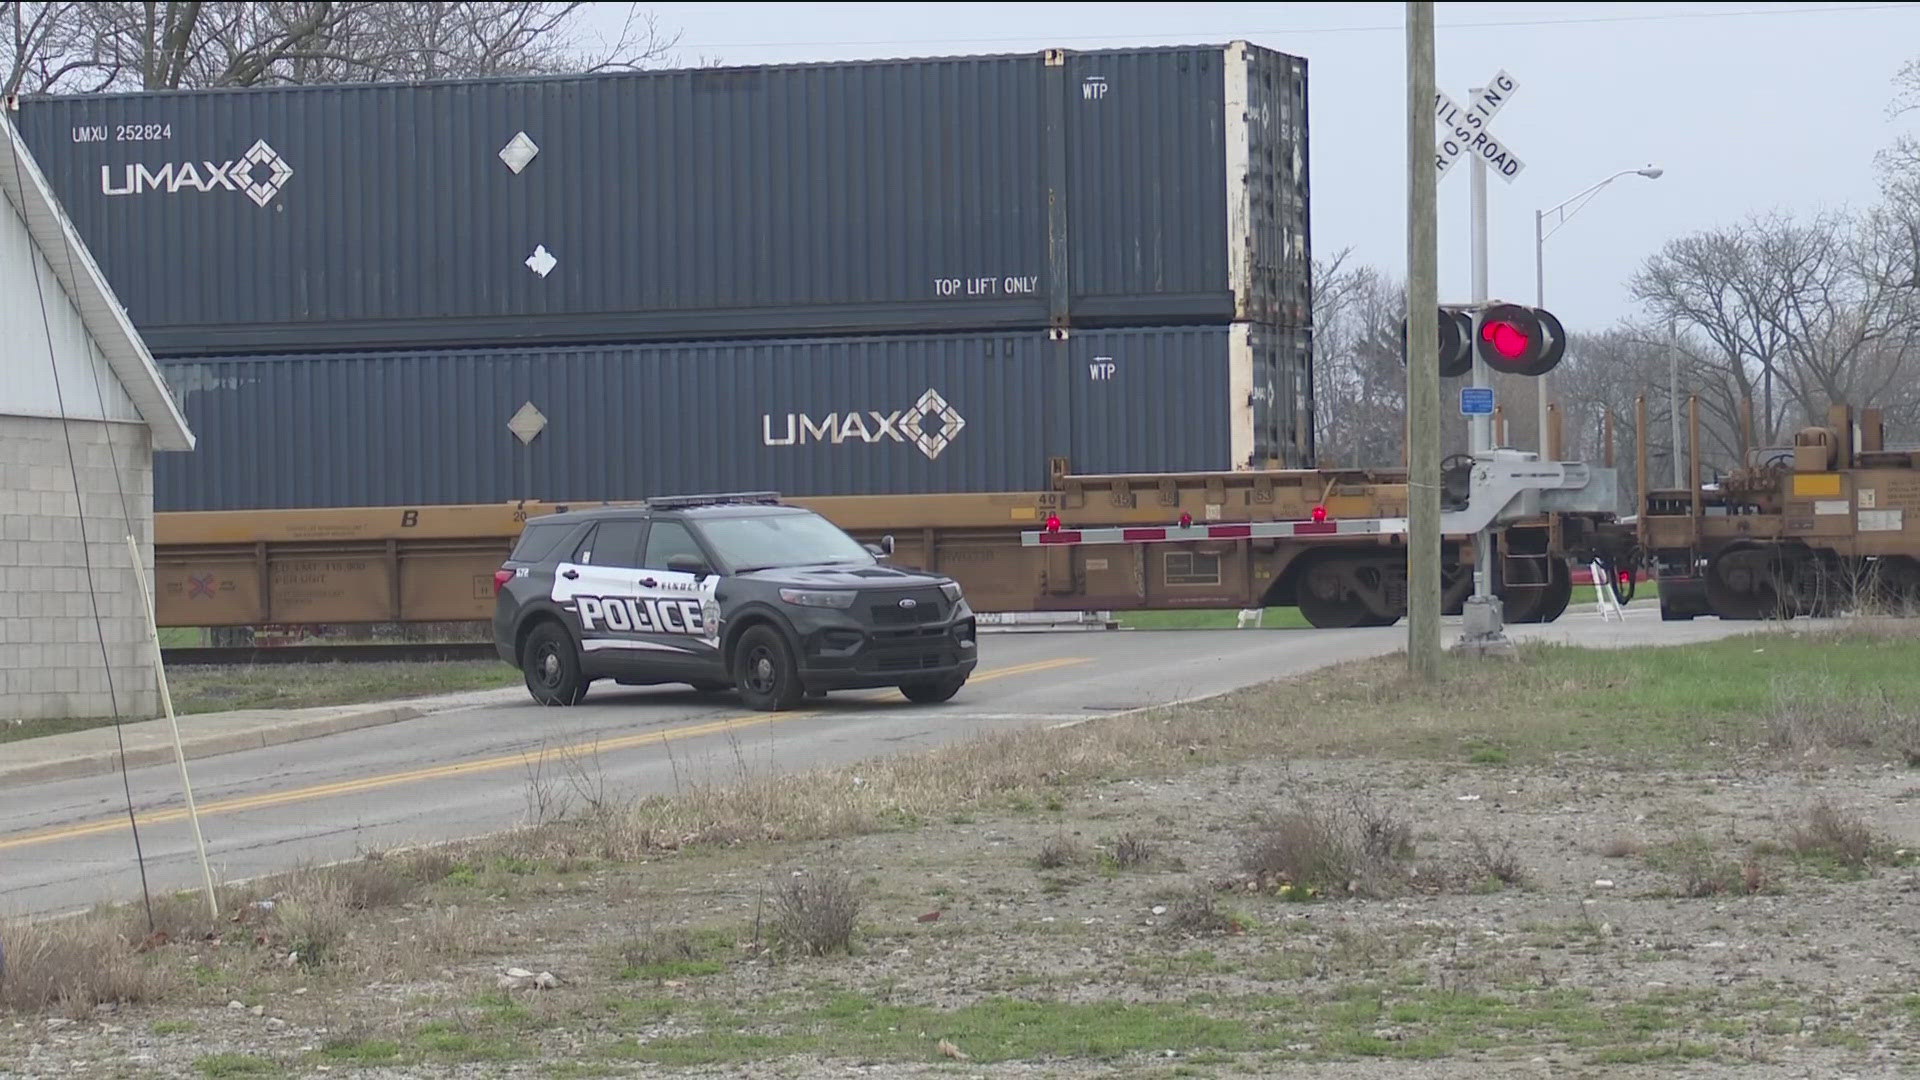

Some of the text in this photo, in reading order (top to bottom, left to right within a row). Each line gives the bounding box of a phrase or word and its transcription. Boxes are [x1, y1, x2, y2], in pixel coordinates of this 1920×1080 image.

[1082, 83, 1108, 99] WTP
[72, 123, 172, 143] UMXU 252824
[1435, 76, 1513, 171] ROSSING
[101, 160, 238, 195] UMAX
[934, 276, 1038, 296] TOP LIFT ONLY
[1089, 363, 1116, 380] WTP
[763, 410, 905, 446] UMAX
[1038, 494, 1056, 505] 40
[401, 509, 419, 528] B
[513, 511, 527, 523] 20
[661, 582, 709, 592] FINDLAY
[573, 595, 705, 635] POLICE
